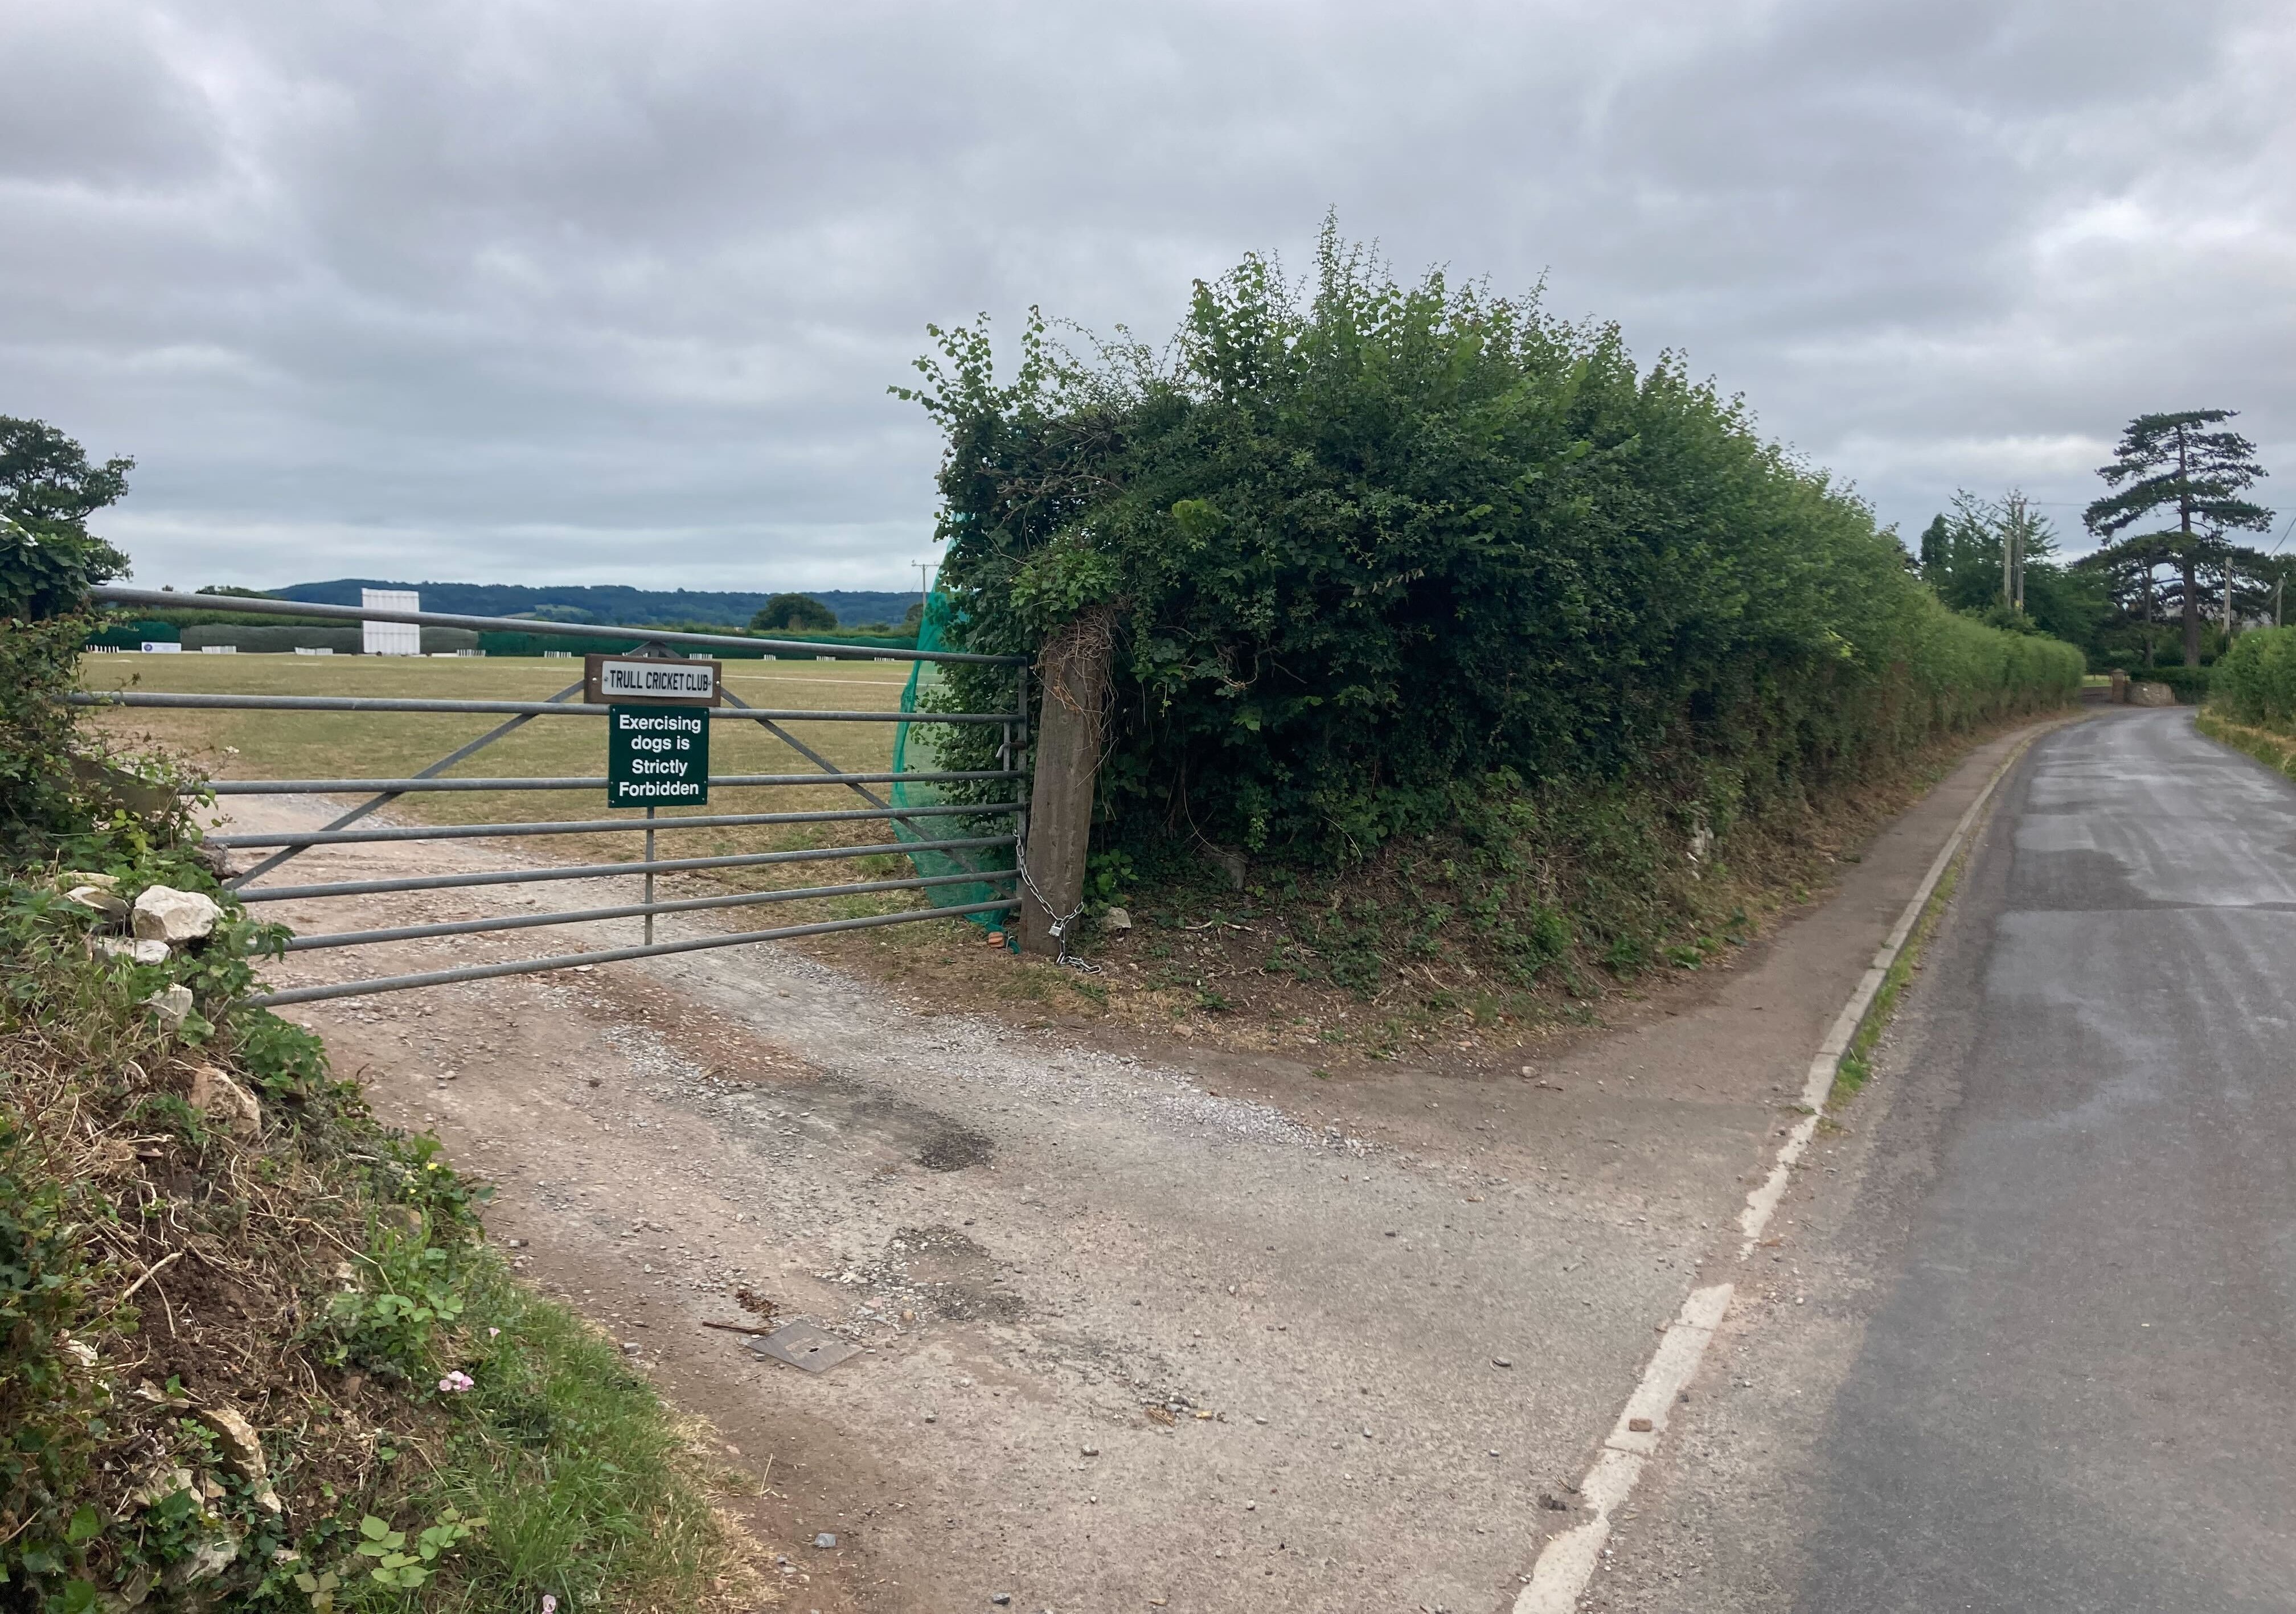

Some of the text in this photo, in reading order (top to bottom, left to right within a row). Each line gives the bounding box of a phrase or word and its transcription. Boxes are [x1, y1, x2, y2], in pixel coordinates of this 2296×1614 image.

[610, 670, 708, 691] TRULL CRICKET CLUB
[620, 714, 701, 733] Exercising
[631, 735, 690, 753] dogs is
[632, 759, 688, 777] Strictly
[619, 782, 699, 796] Forbidden
